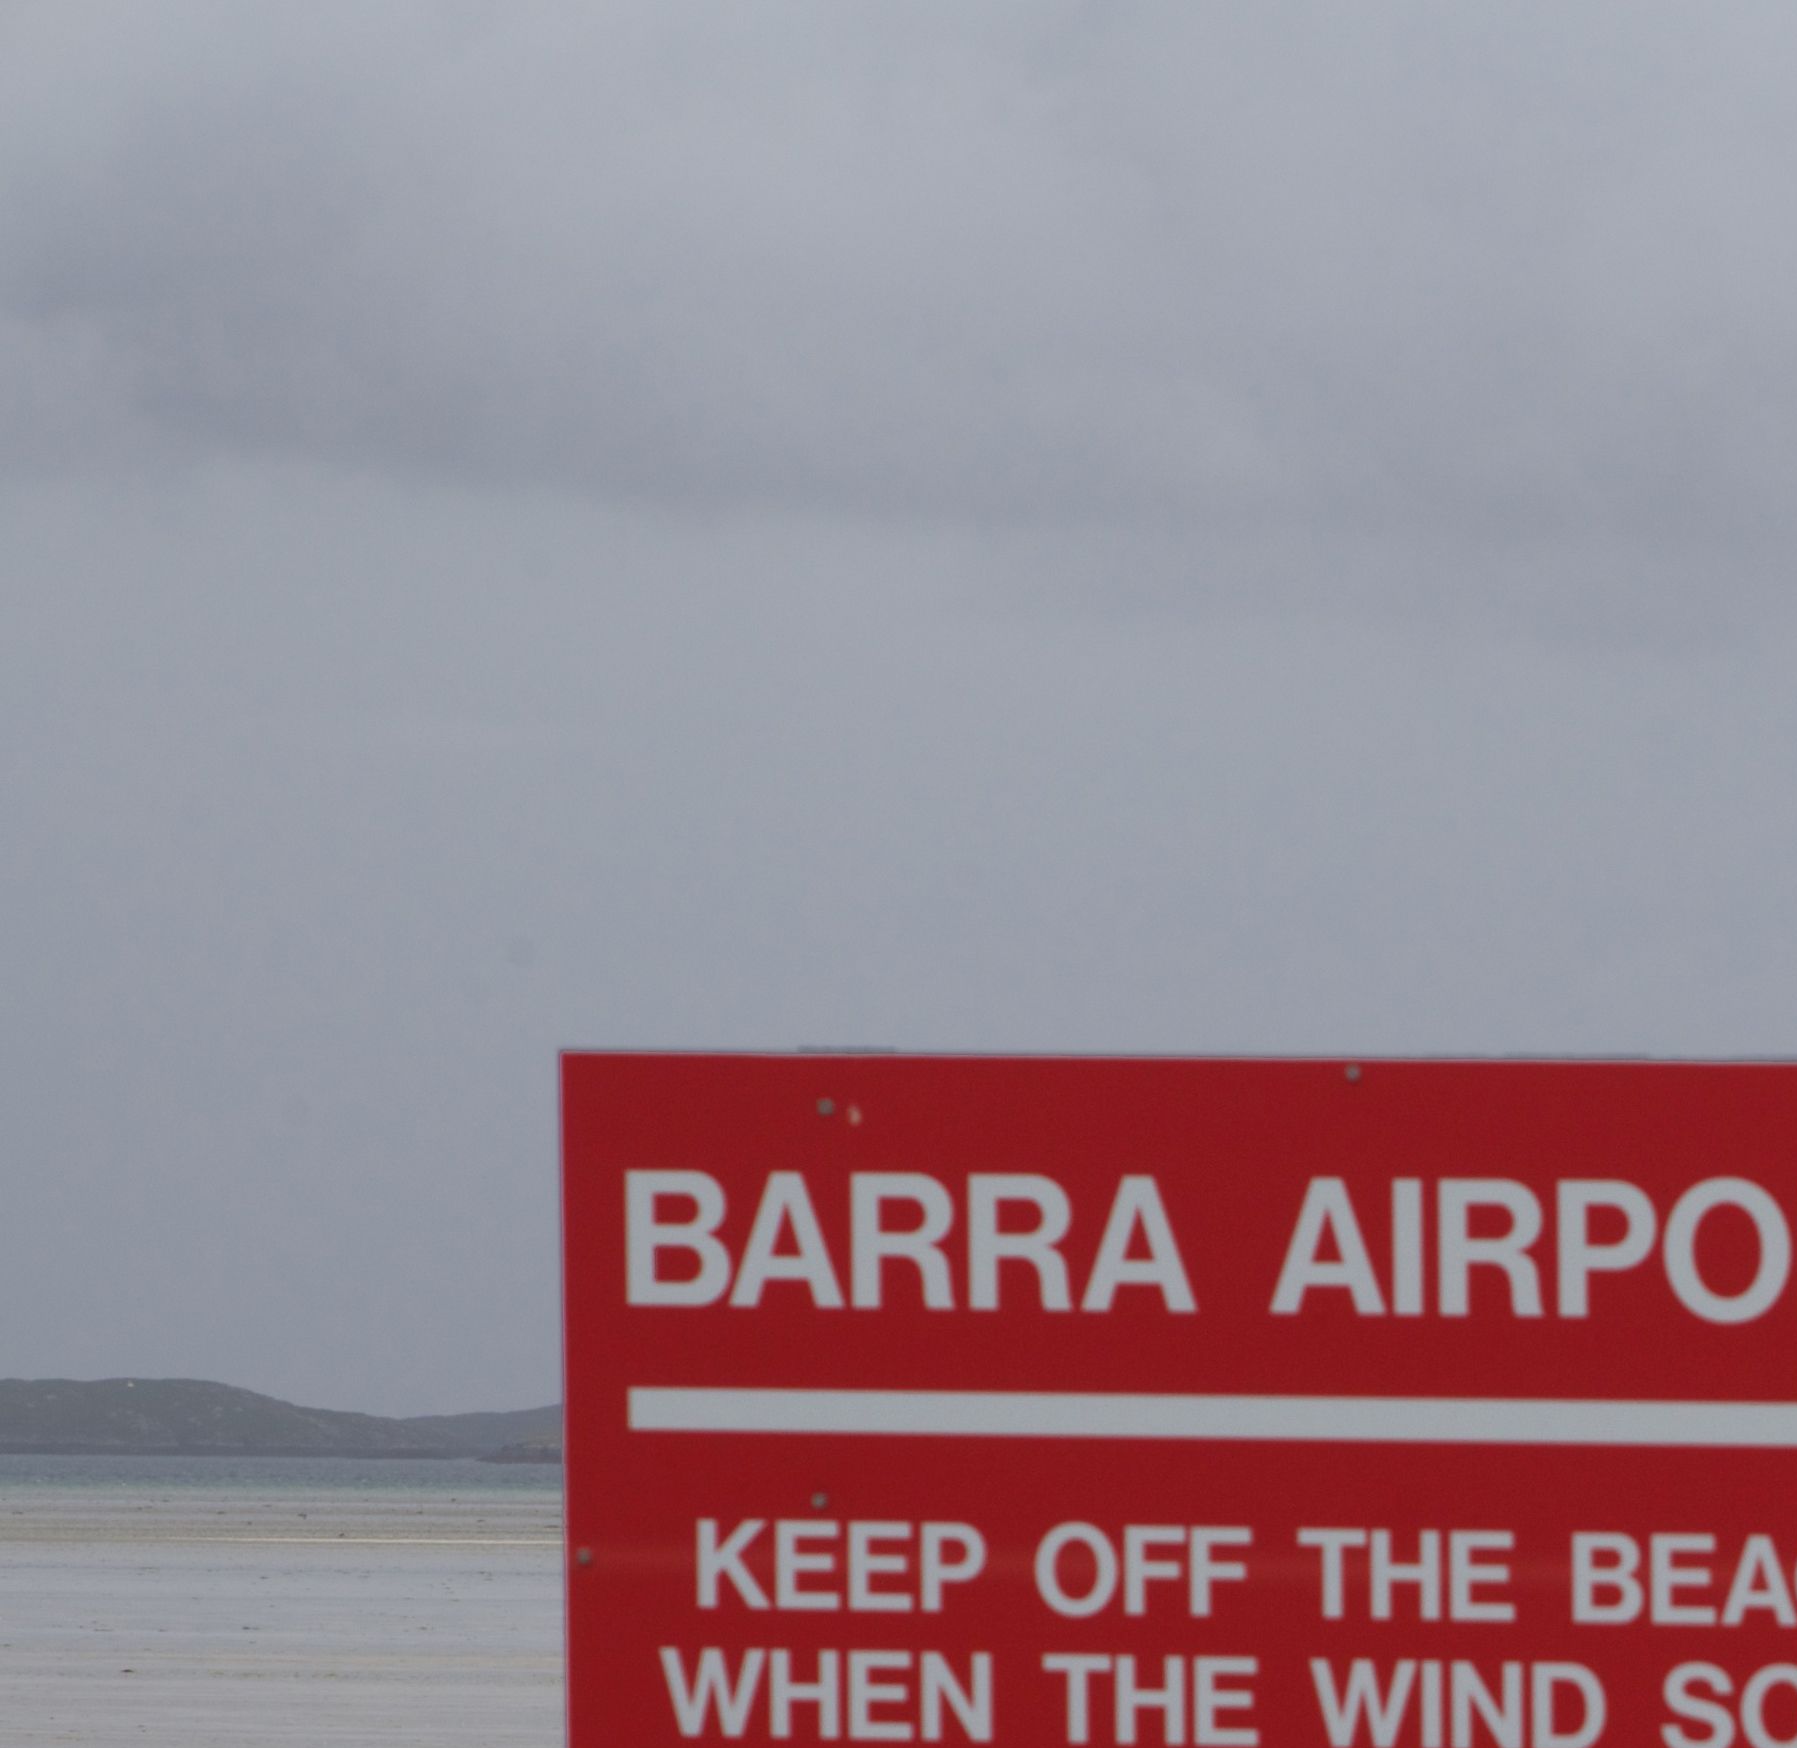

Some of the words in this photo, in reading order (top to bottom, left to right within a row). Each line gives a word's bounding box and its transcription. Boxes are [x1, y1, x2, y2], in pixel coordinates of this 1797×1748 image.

[625, 1170, 1196, 1312] BARRA
[697, 1519, 985, 1612] KEEP
[1035, 1522, 1252, 1616] OFF
[1297, 1528, 1515, 1622] THE
[661, 1647, 992, 1742] WHEN
[1043, 1653, 1258, 1747] THE
